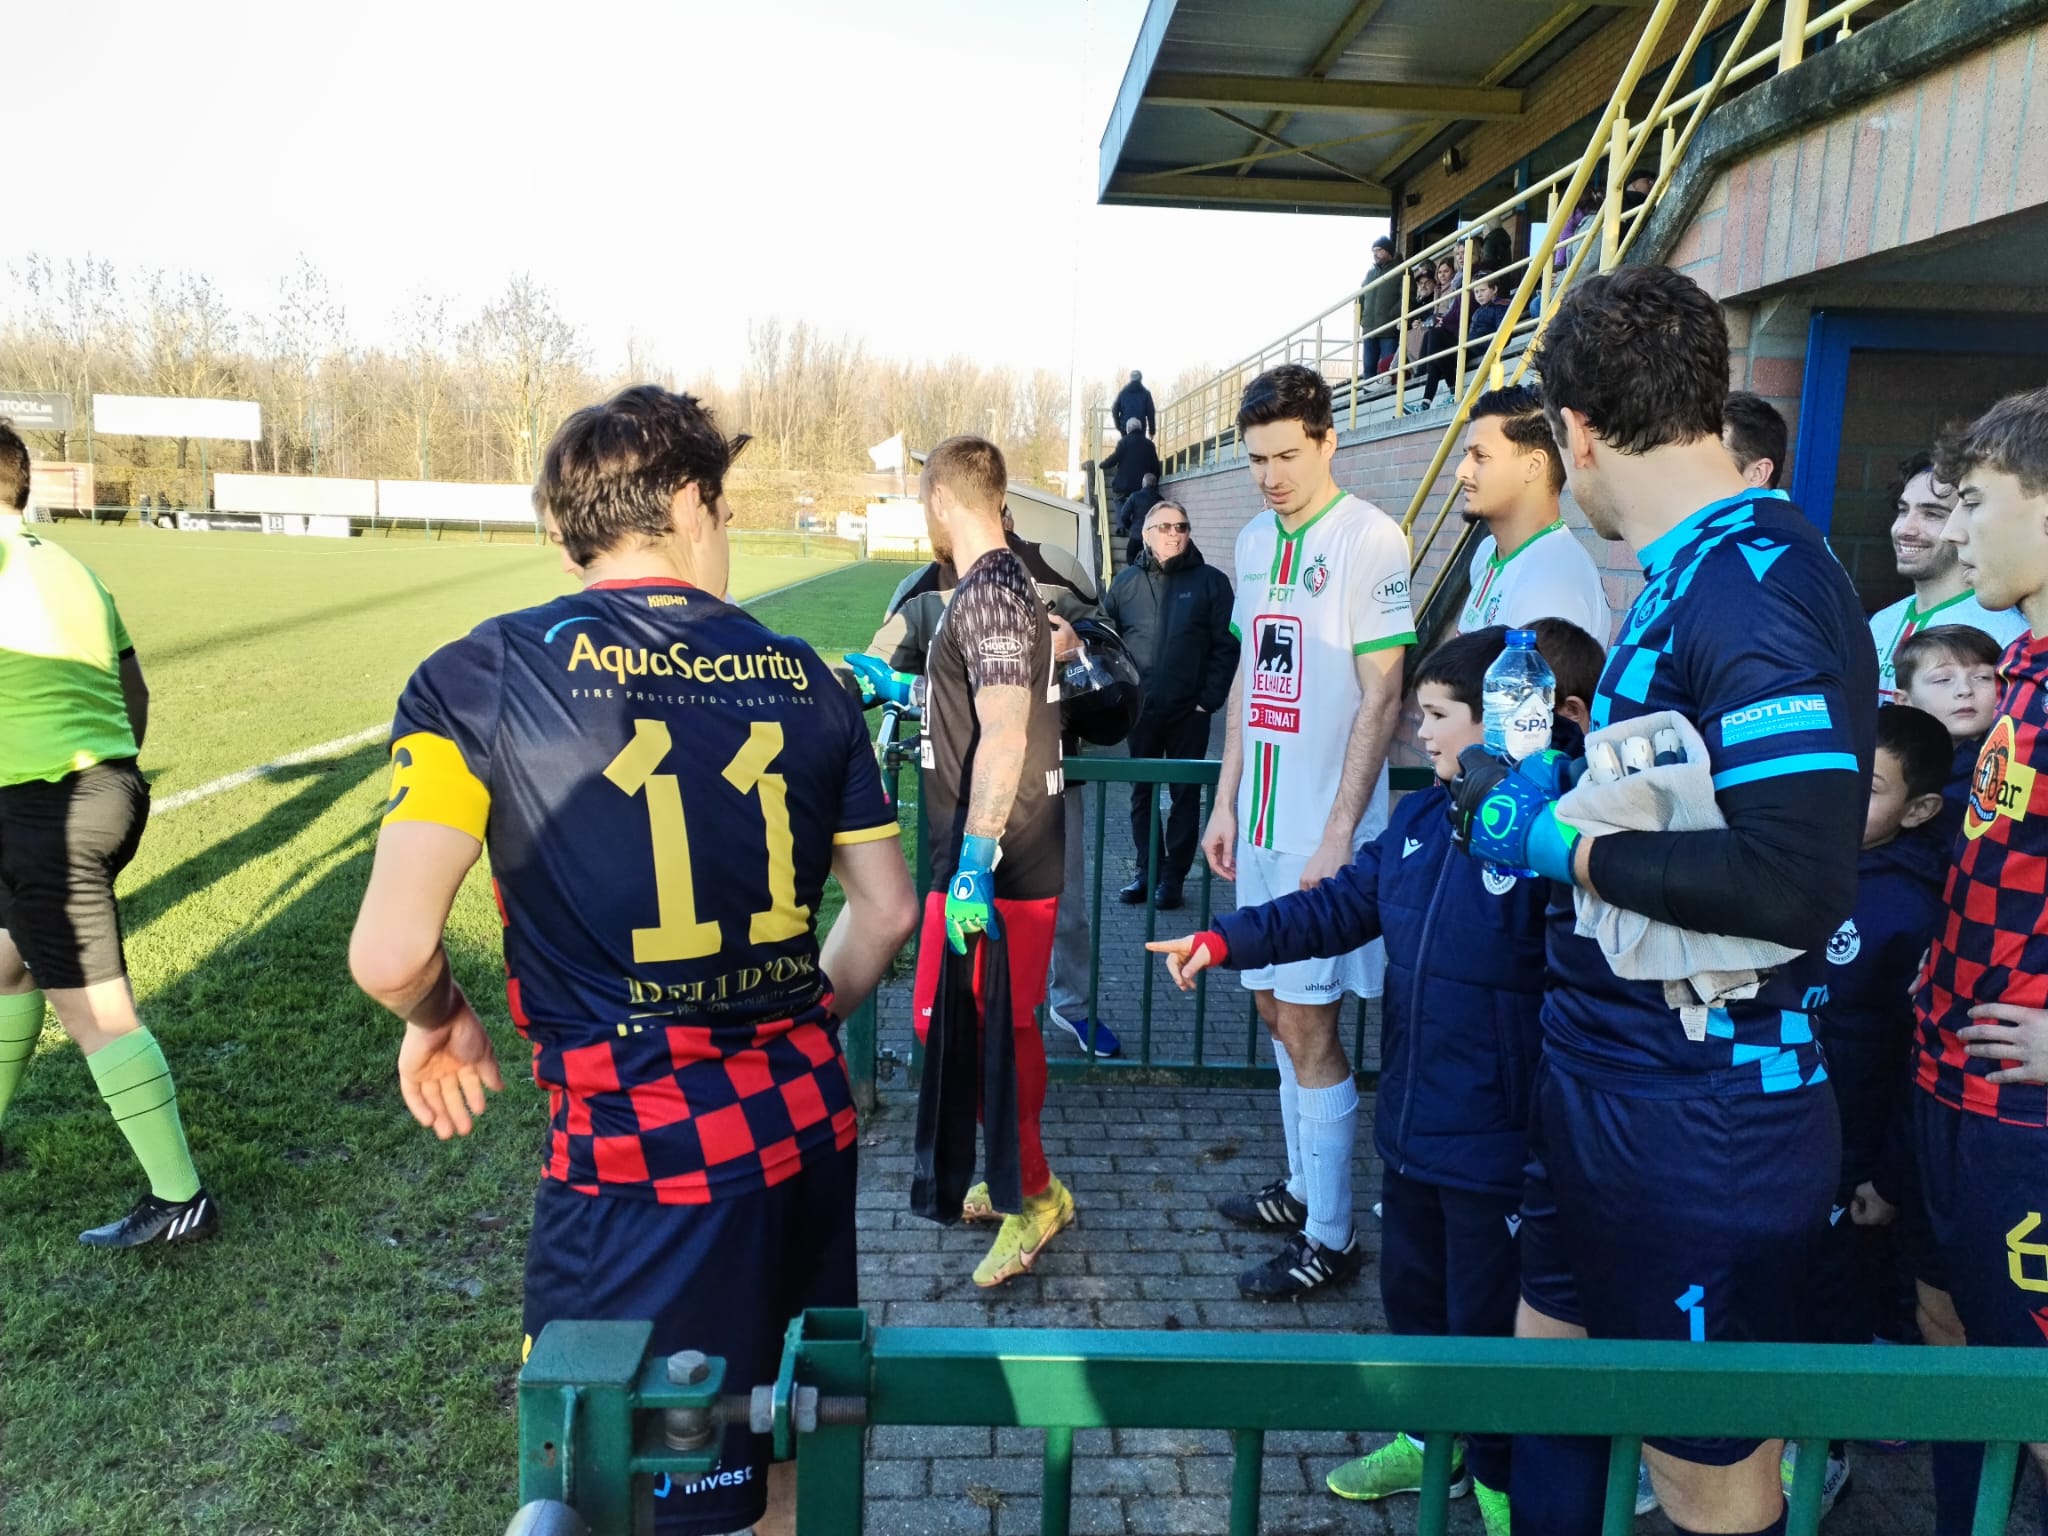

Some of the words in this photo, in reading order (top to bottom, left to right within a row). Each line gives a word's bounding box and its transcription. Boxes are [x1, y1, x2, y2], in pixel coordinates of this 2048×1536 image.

[567, 633, 808, 690] AquaSecurity
[572, 688, 613, 699] FIRE
[626, 691, 727, 705] PROTECTION
[1513, 718, 1548, 732] SPA
[1721, 699, 1828, 728] FOOTLINE
[603, 719, 810, 963] 11
[624, 974, 728, 1005] DELI
[1675, 1284, 1705, 1343] 1
